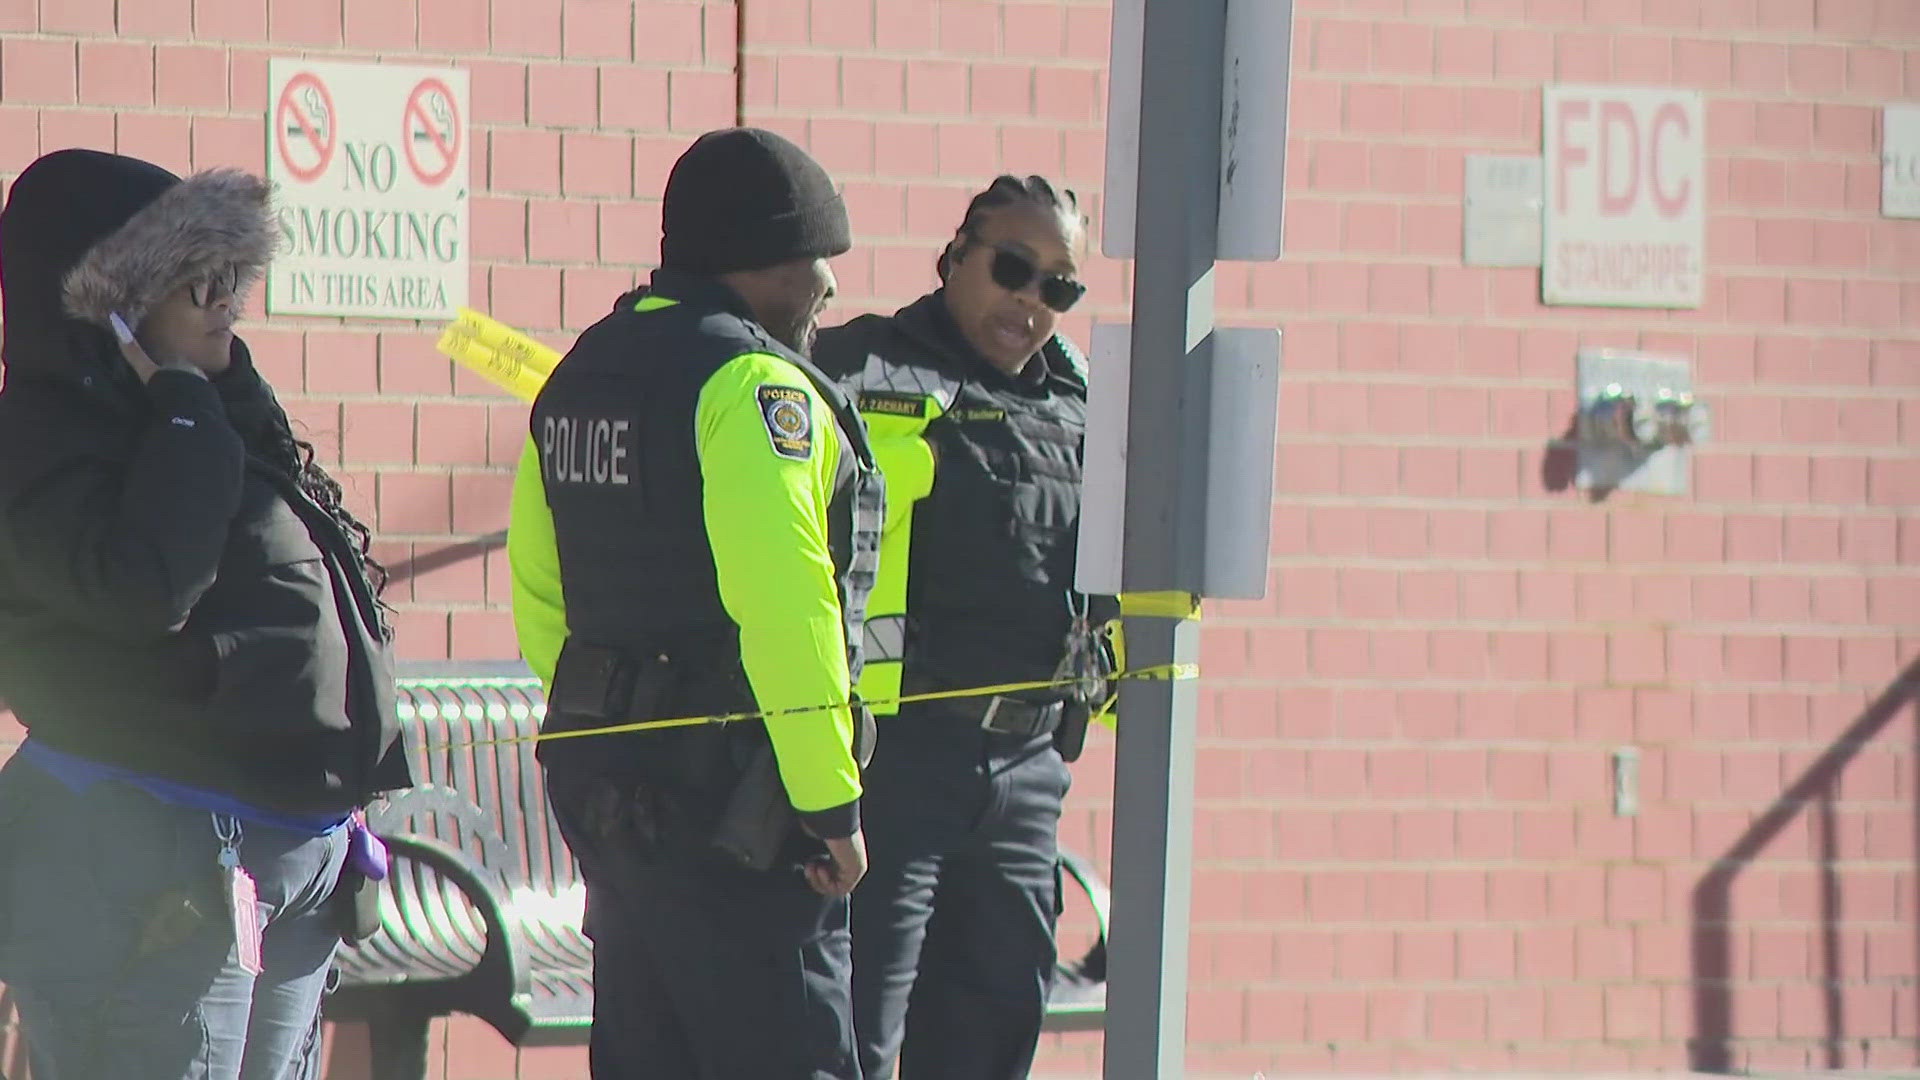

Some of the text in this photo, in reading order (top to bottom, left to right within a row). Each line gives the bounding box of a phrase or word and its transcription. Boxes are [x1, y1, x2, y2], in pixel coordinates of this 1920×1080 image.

[342, 141, 398, 194] NO
[1556, 99, 1690, 218] FDC
[278, 206, 460, 264] SMOKING
[291, 272, 449, 310] IN THIS AREA
[1556, 241, 1692, 292] STANDPIPE
[762, 388, 806, 404] POLICE
[544, 416, 630, 485] POLICE
